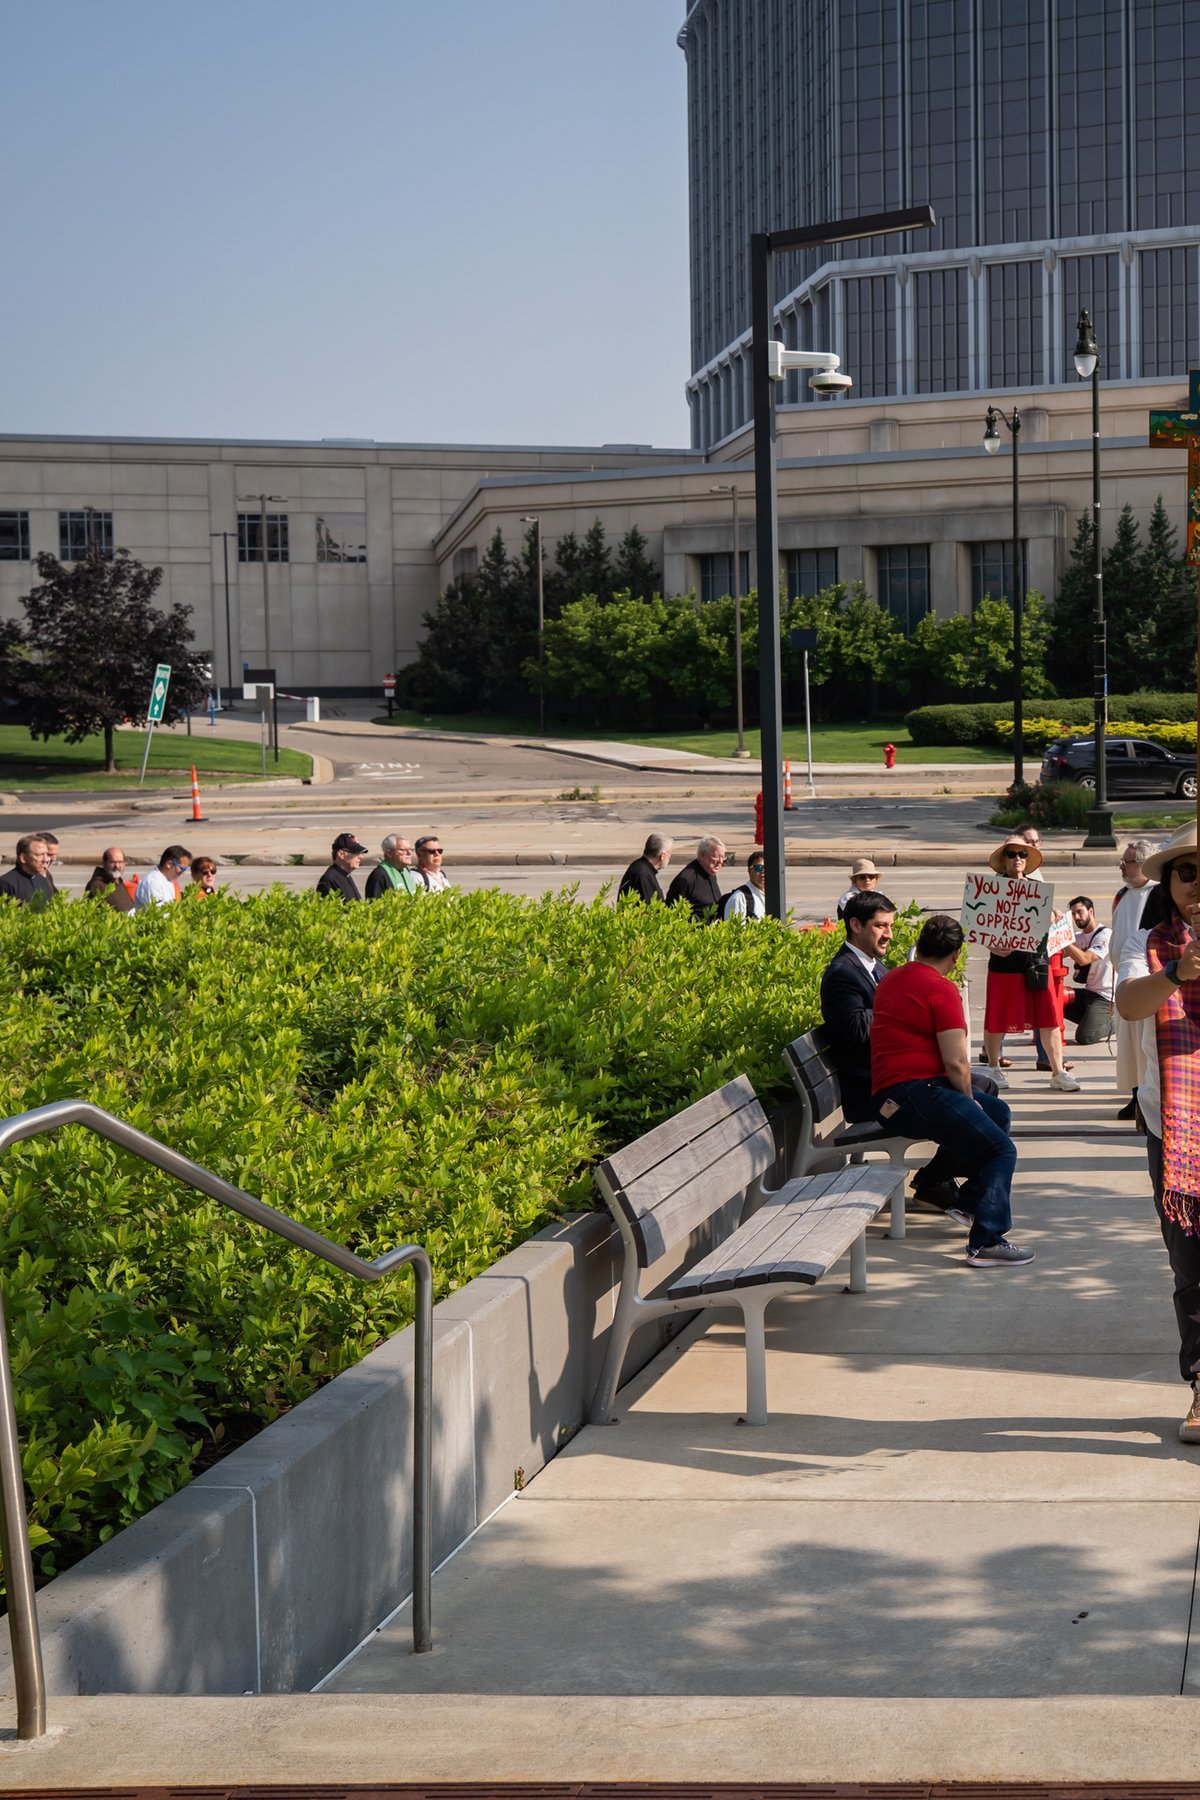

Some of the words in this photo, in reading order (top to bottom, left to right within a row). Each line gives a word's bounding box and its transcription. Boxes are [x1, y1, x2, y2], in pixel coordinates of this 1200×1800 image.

[1006, 880, 1041, 901] SHALL
[996, 899, 1020, 916] NOT
[976, 913, 1030, 933] OPPRESS
